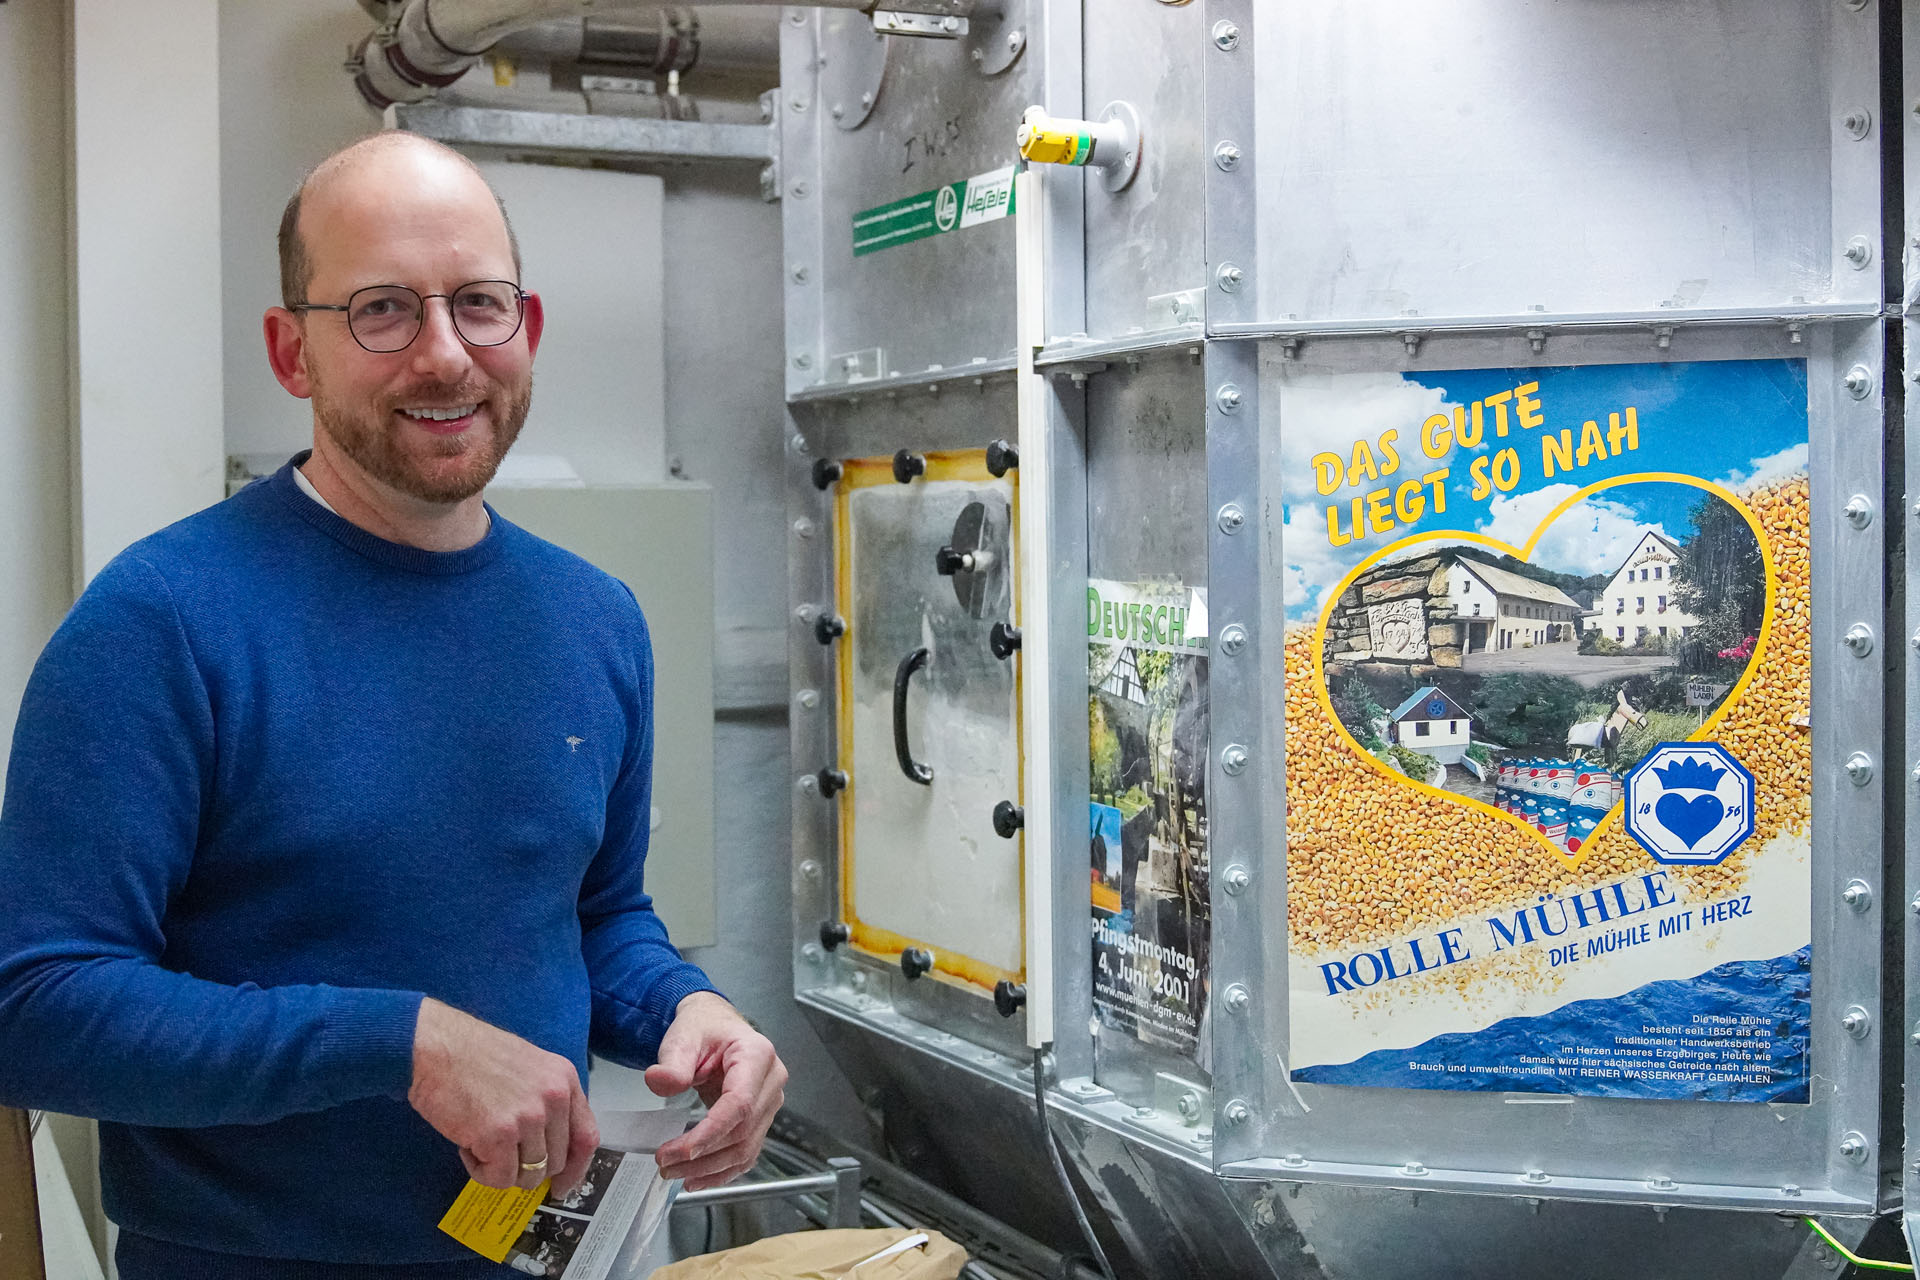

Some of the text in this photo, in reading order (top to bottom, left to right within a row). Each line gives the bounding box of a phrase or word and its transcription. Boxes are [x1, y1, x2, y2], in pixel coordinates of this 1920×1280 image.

[1311, 381, 1544, 496] DAS GUTE
[1326, 406, 1639, 547] LIEGT SO NAH
[1088, 586, 1208, 648] DEUTSCH
[1638, 803, 1741, 818] 18 56
[1092, 918, 1200, 980] Pfingstmontag,
[1317, 870, 1676, 997] ROLLE MÜHLE
[1549, 895, 1753, 967] DIE MÜHLE MIT HERZ
[1098, 951, 1190, 1004] 4. Juni 2001
[1643, 1025, 1771, 1038] besteht seit 1856 als ein
[1692, 1015, 1772, 1026] Die Rolle Mühle
[1561, 1045, 1772, 1062] im Herzen unseres Erzgebirges. Heute wie
[1615, 1035, 1771, 1050] traditioneller Handwerksbetrieb
[1409, 1061, 1774, 1085] Brauch und umweltfreundlich MIT REINER WASSERKRAFT GEMAHLEN.
[1520, 1055, 1771, 1073] damals wird hier sächsisches Getreide nach altem
